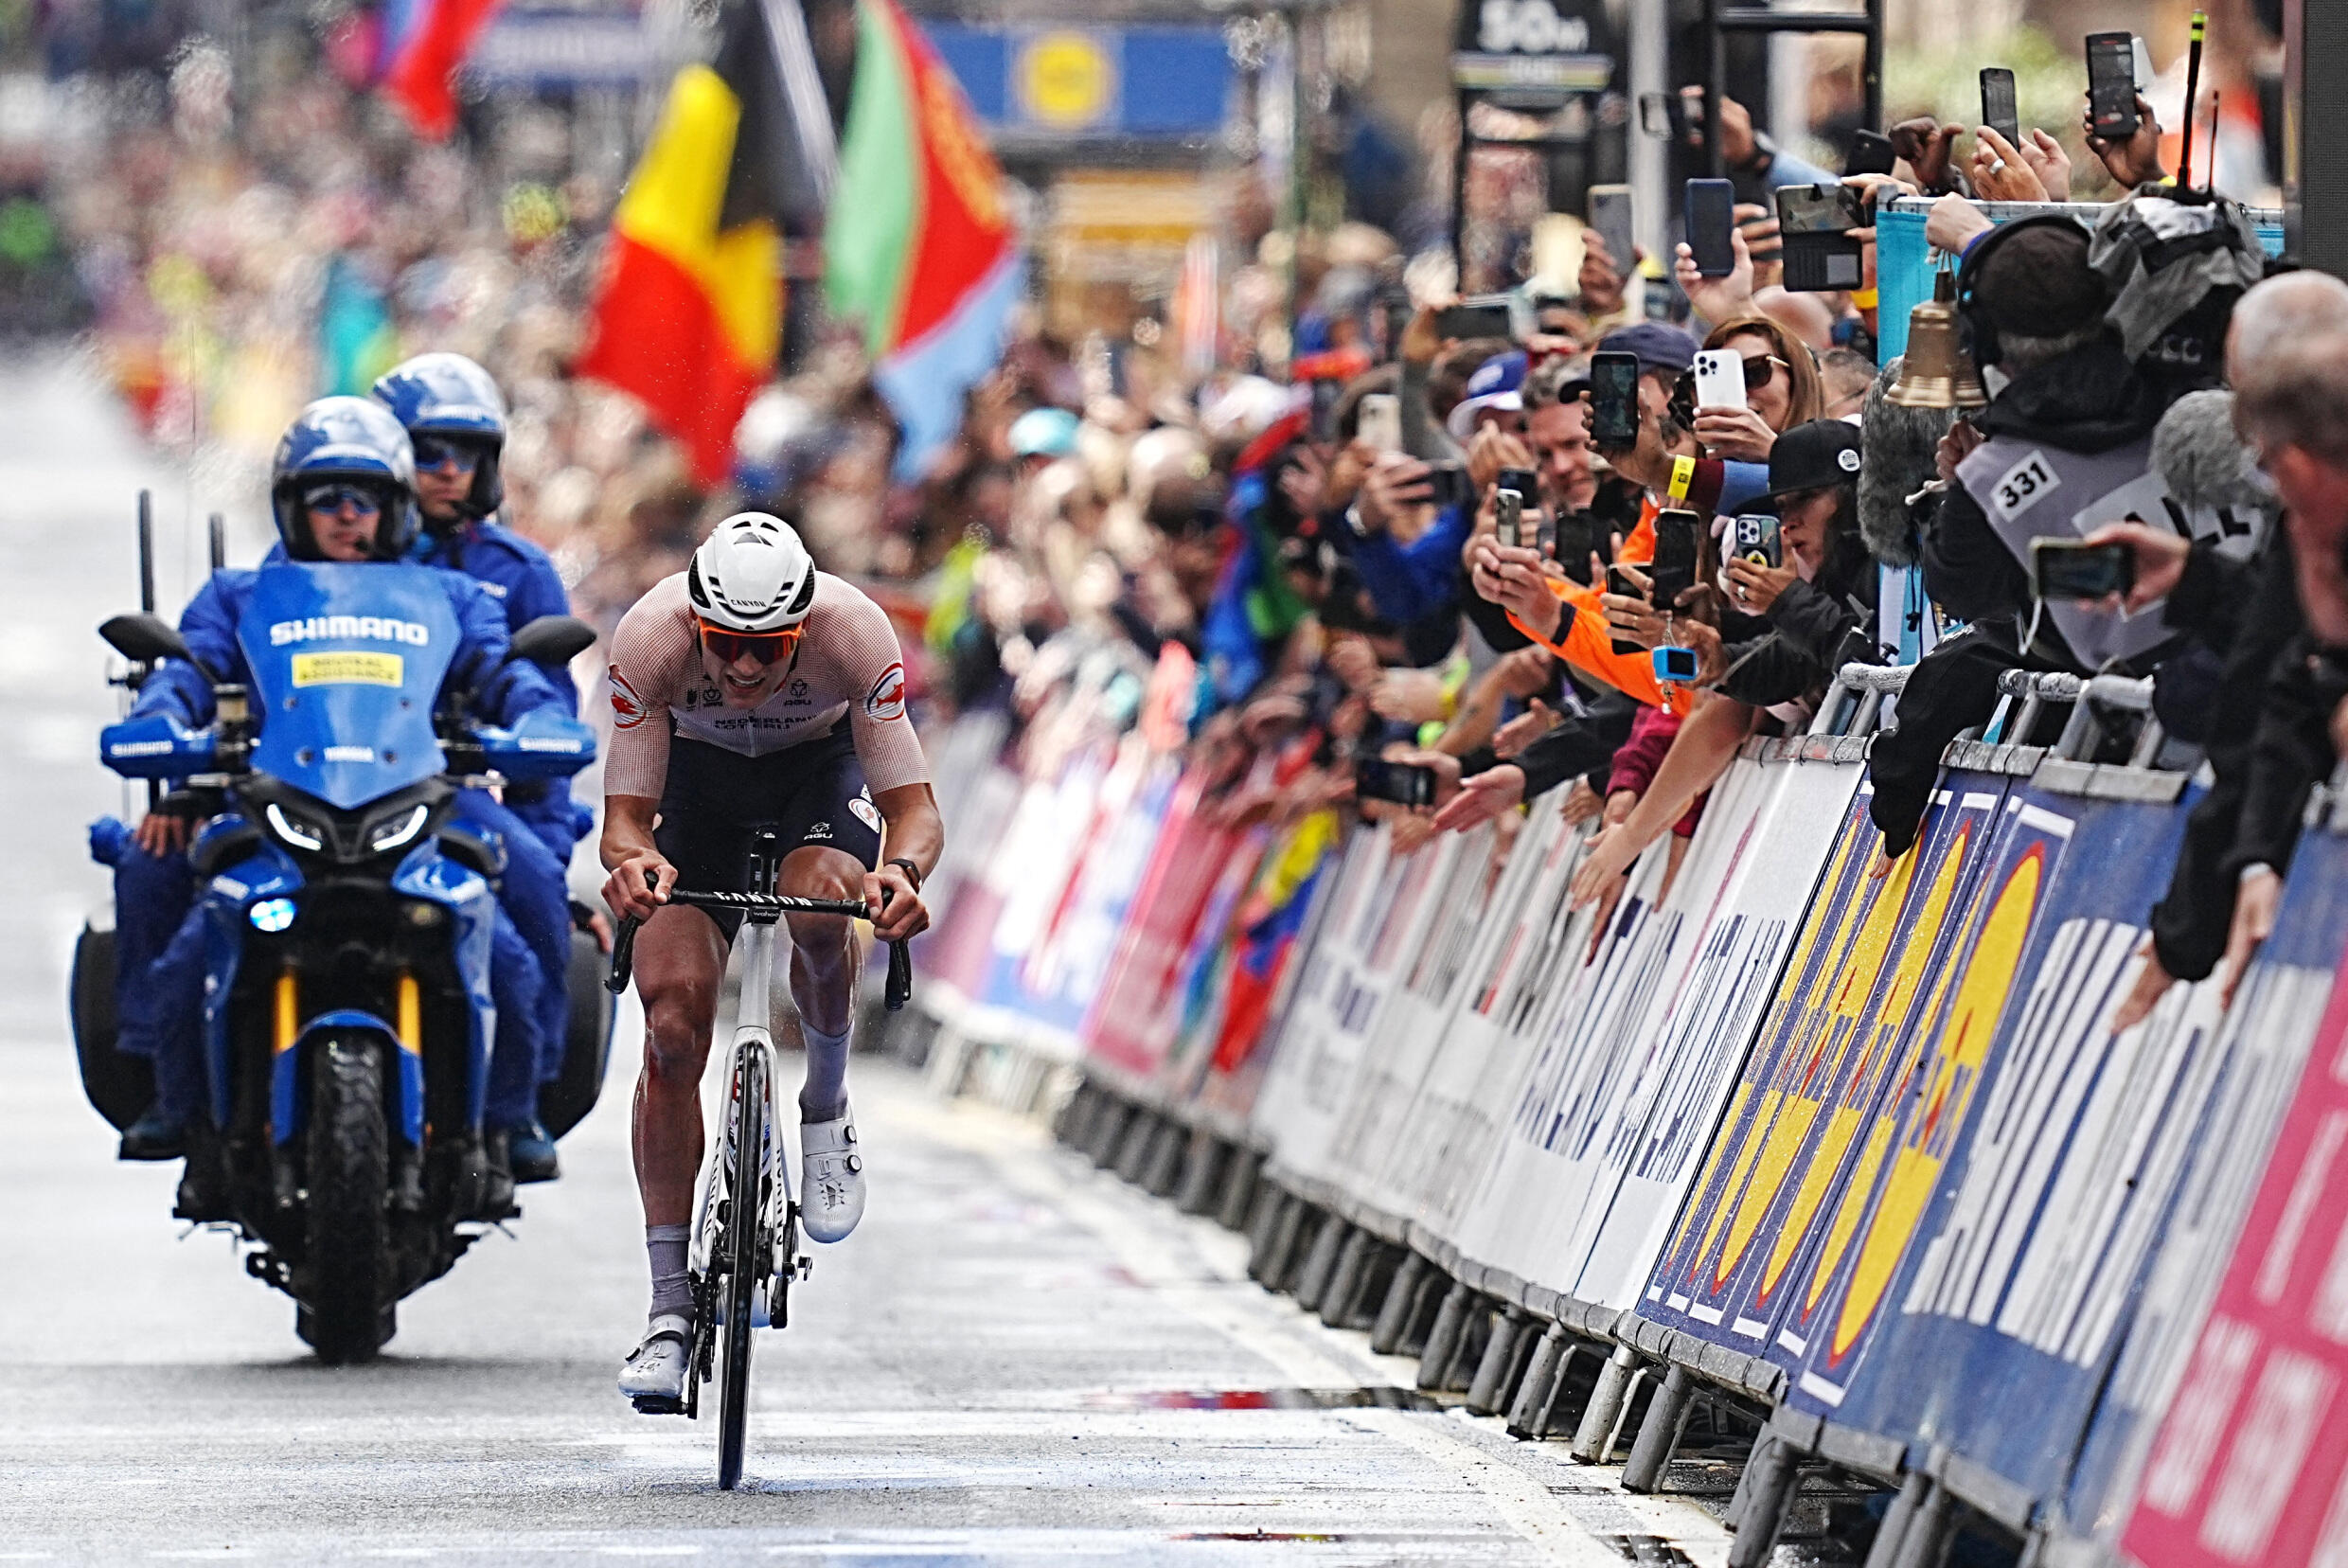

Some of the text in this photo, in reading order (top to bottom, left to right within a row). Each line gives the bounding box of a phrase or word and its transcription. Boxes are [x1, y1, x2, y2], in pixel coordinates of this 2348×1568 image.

[2000, 462, 2049, 508] 331
[730, 598, 767, 607] CANYON
[269, 615, 429, 647] SHIMANO
[804, 832, 833, 841] AGU
